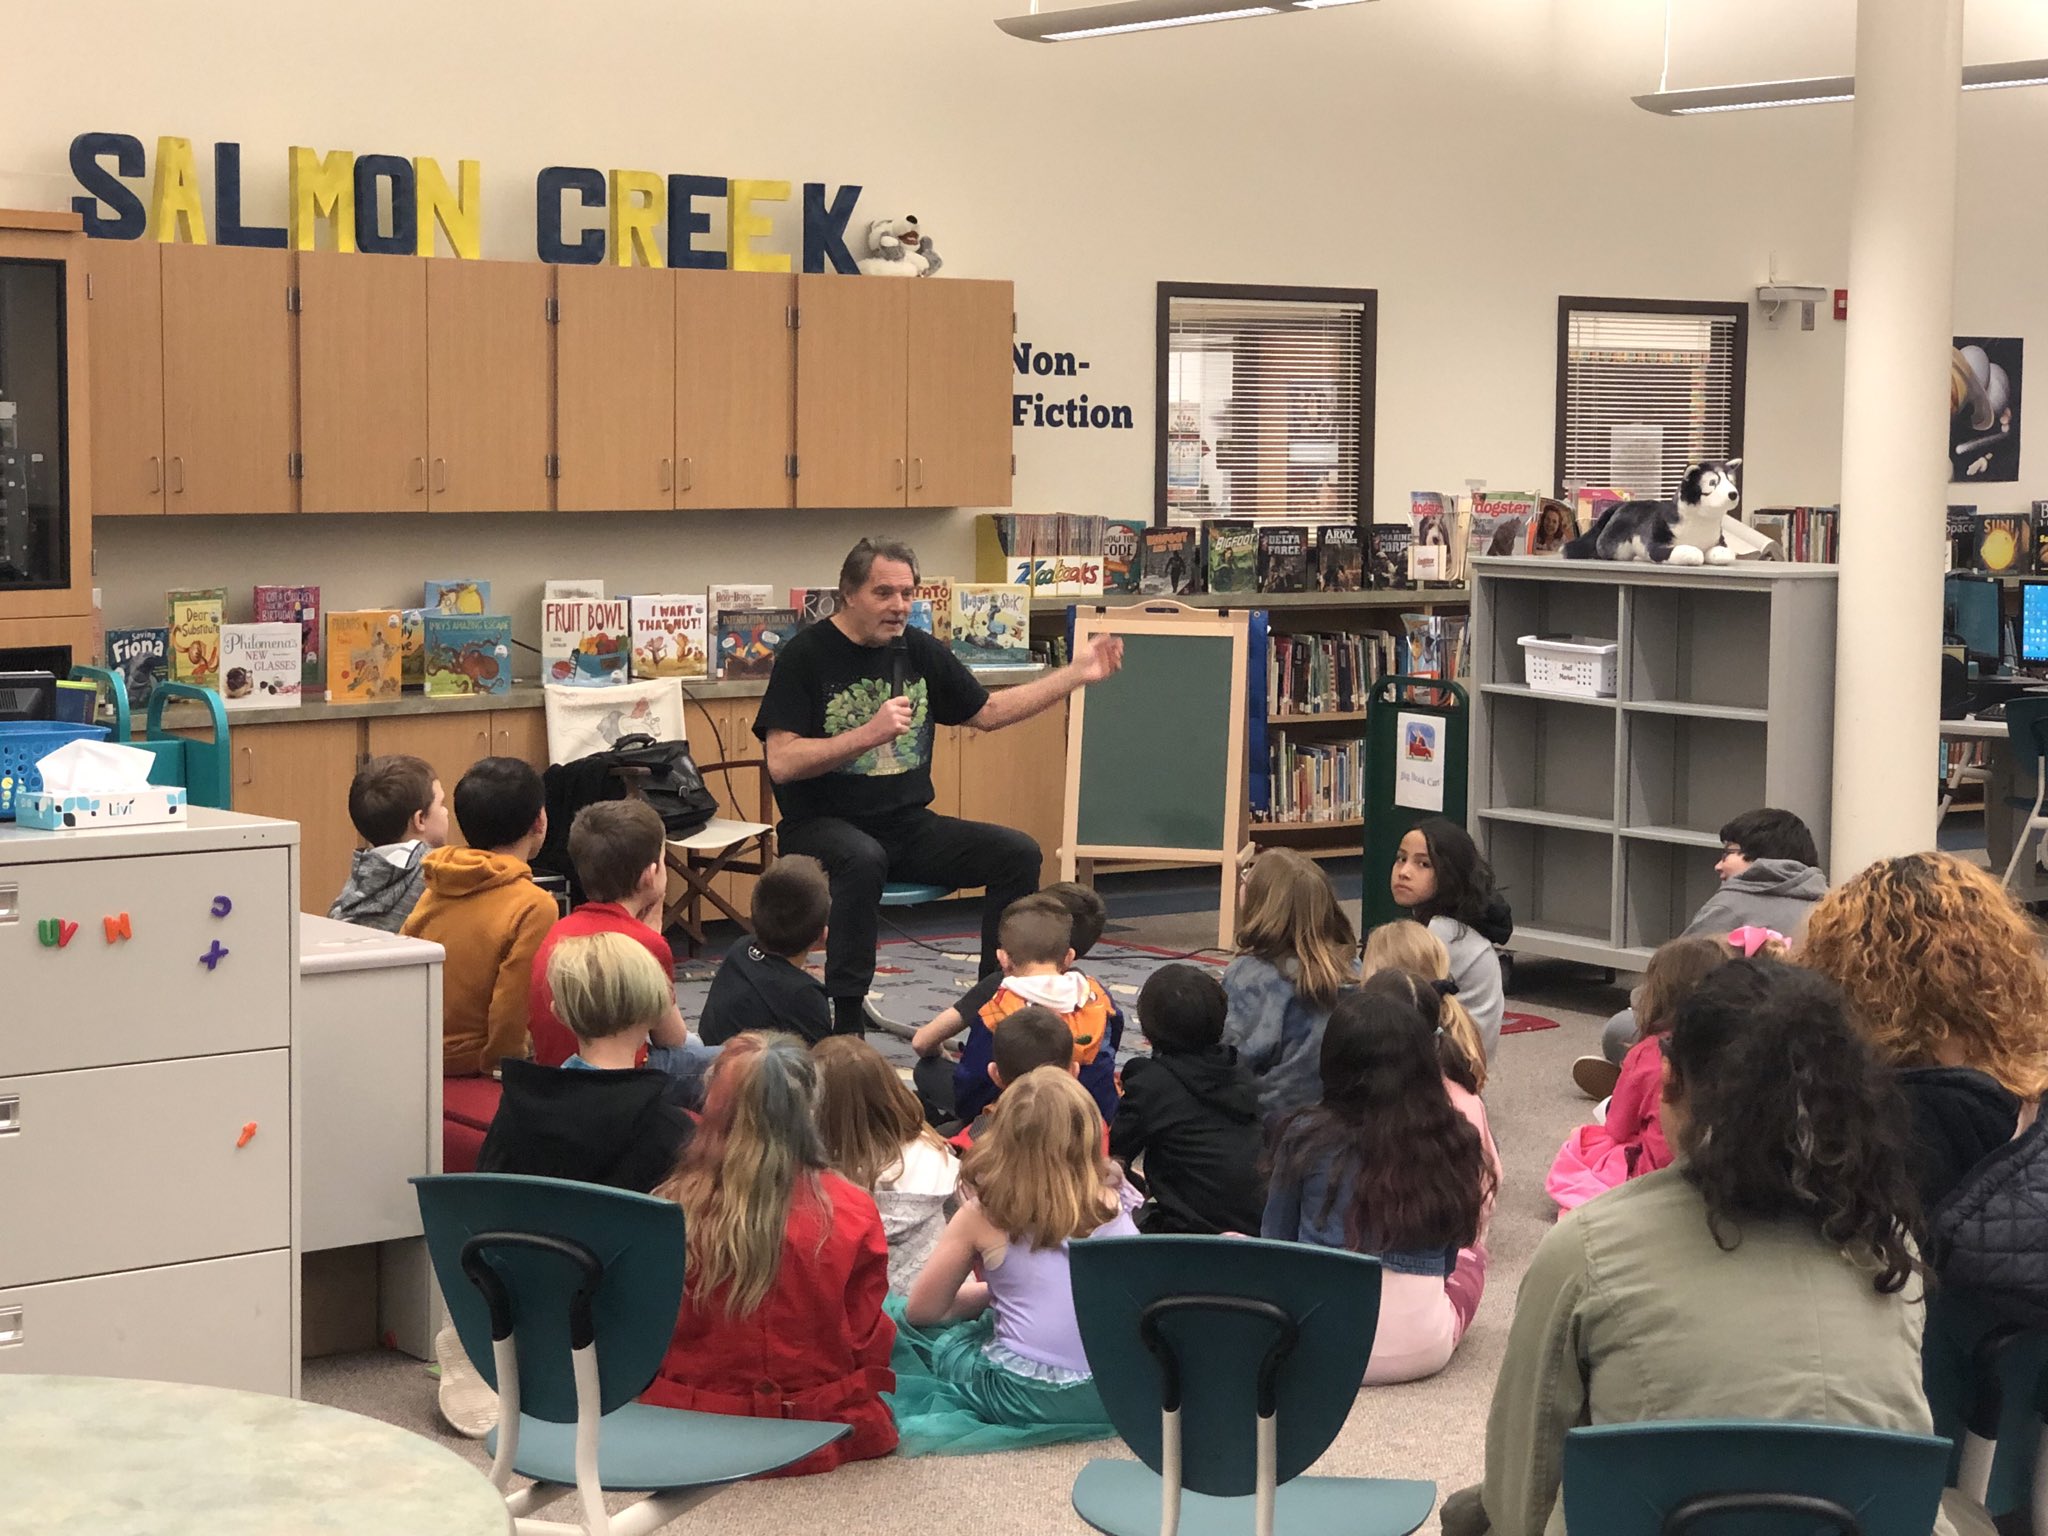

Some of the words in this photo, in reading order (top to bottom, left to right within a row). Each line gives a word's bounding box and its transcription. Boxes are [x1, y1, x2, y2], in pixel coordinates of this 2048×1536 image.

[69, 132, 481, 261] SALMON
[537, 166, 863, 275] CREEK
[1013, 342, 1090, 376] Non-
[1013, 393, 1134, 428] Fiction
[1475, 501, 1531, 517] dogster
[1268, 534, 1301, 545] DELTA
[1325, 528, 1355, 540] ARMY
[1103, 543, 1133, 556] CODE
[1215, 533, 1257, 551] BIGFOOT
[1268, 545, 1301, 555] FORCE
[1014, 559, 1100, 587] Zoobooks
[186, 607, 209, 622] Dear
[546, 603, 583, 633] FRUIT
[588, 602, 625, 631] BOWL
[651, 605, 656, 617] I
[660, 605, 693, 617] WANT
[182, 623, 220, 637] Substitute
[638, 618, 669, 631] THAT
[673, 617, 701, 630] NUT!
[131, 630, 156, 641] Saving
[112, 639, 164, 663] Fiona
[245, 650, 269, 661] NEW
[254, 660, 297, 672] GLASSES
[1411, 771, 1426, 785] Book
[1427, 777, 1440, 787] Cart
[109, 797, 135, 817] Livi
